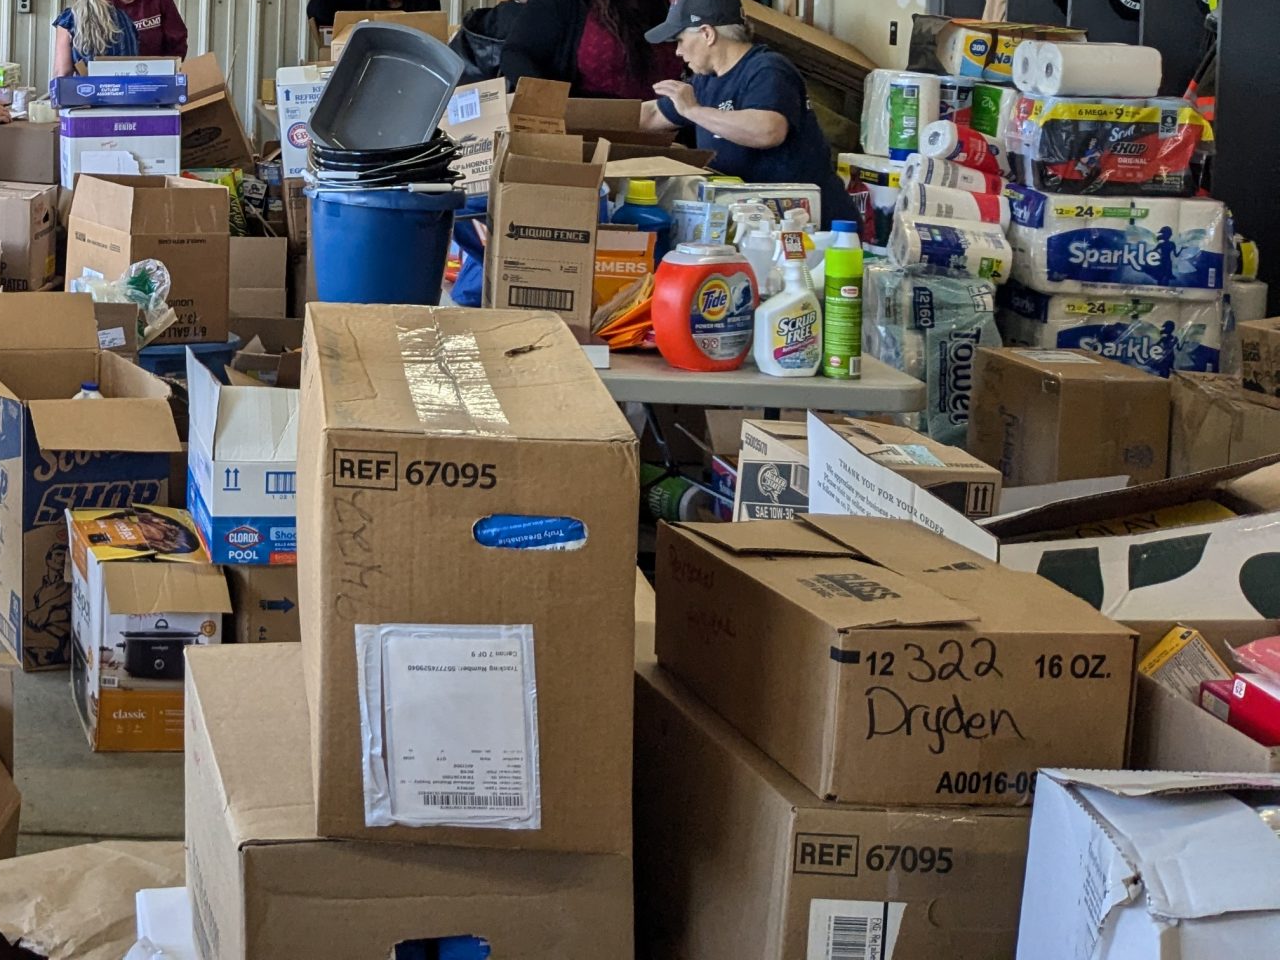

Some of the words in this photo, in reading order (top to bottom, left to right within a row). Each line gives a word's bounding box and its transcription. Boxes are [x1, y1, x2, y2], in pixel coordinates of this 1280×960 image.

[972, 43, 986, 51] 300
[1084, 109, 1108, 117] MEGA
[1114, 107, 1124, 120] 9
[1109, 142, 1148, 155] SHOP
[1075, 205, 1094, 218] 24
[520, 227, 552, 239] LIQUID
[553, 230, 585, 241] FENCE
[1069, 241, 1162, 271] Sparkle
[702, 290, 728, 315] Tide
[1087, 302, 1106, 314] 24
[777, 310, 817, 337] SCRUB
[786, 324, 812, 345] FREE
[1079, 334, 1165, 365] Sparkle
[339, 457, 392, 481] REF
[405, 459, 497, 490] 67095
[33, 479, 160, 526] SHOP
[838, 457, 861, 481] THANK
[861, 476, 876, 492] YOU
[877, 487, 894, 504] FOR
[896, 497, 918, 518] YOUR
[919, 512, 945, 537] ORDER
[755, 505, 769, 518] SAE
[228, 531, 260, 544] CLOROX
[498, 531, 542, 545] Breathable
[543, 528, 565, 539] Truly
[228, 550, 259, 560] POOL
[866, 651, 895, 676] 12
[904, 637, 1003, 682] 322
[1035, 654, 1062, 679] 16
[1070, 654, 1112, 679] OZ.
[113, 708, 147, 720] classic
[865, 686, 1027, 755] Dryden
[935, 770, 1037, 795] A0016-08
[800, 841, 853, 867] REF
[866, 844, 954, 874] 67095
